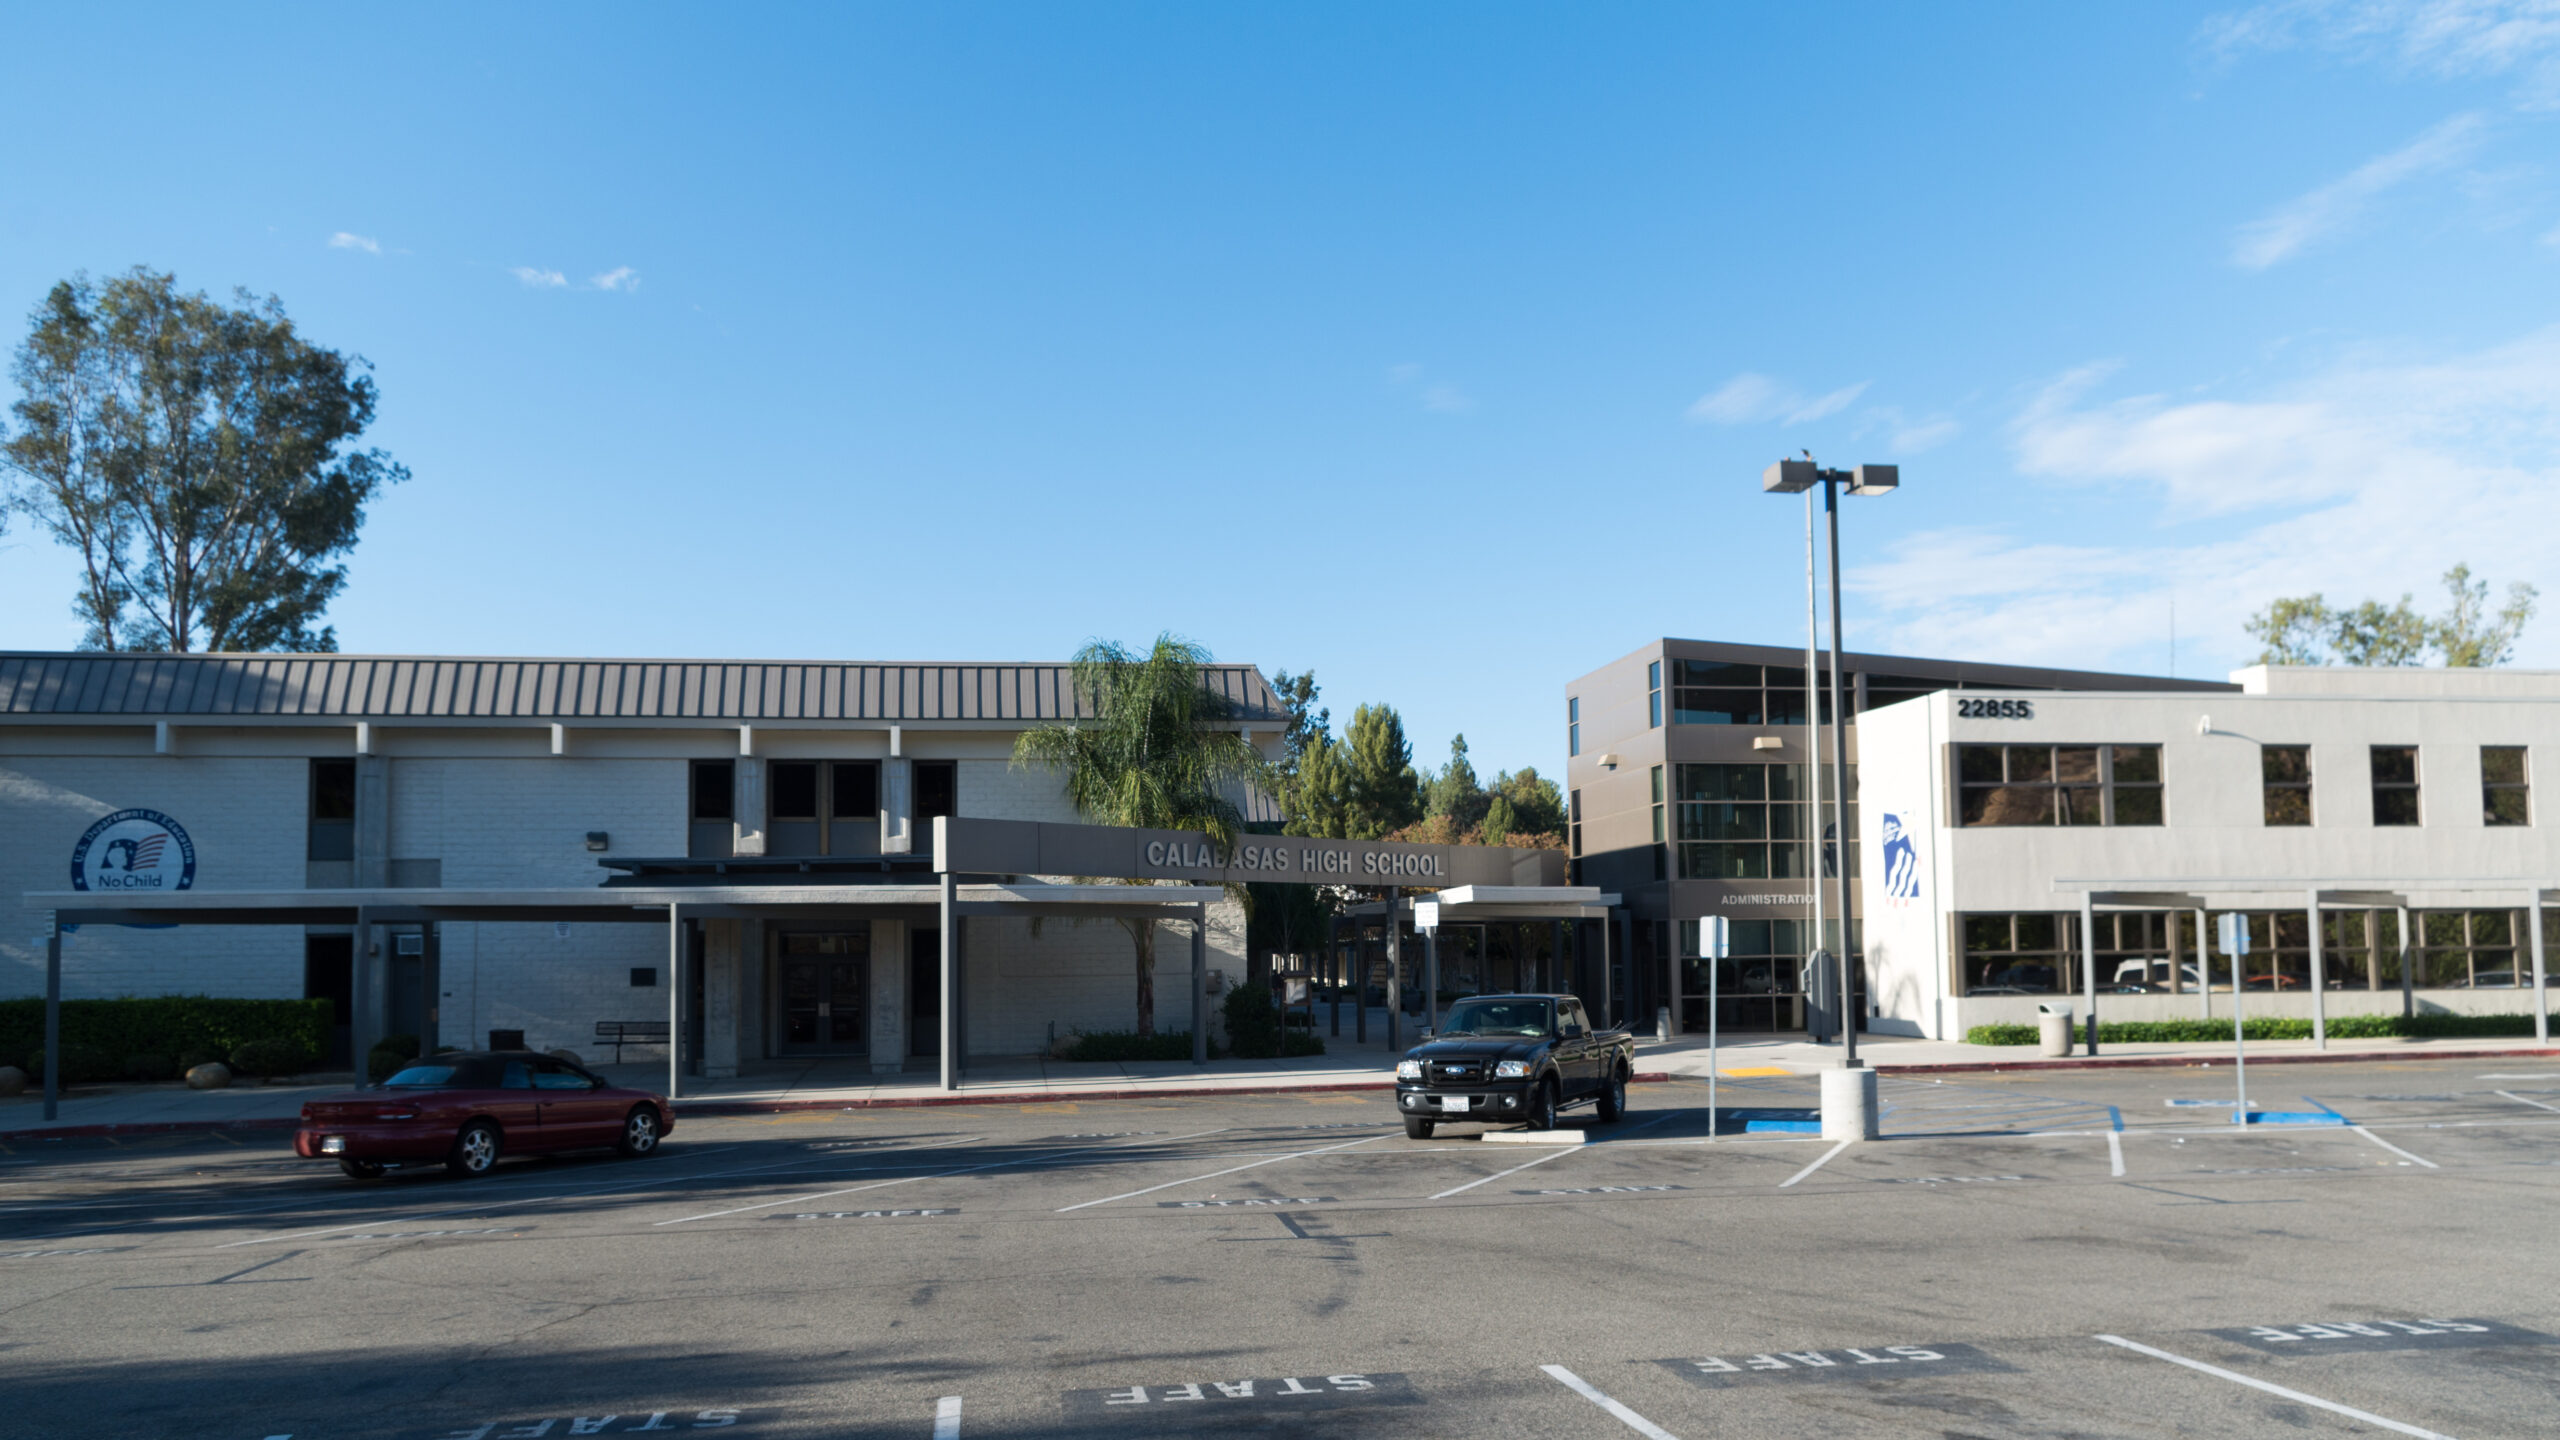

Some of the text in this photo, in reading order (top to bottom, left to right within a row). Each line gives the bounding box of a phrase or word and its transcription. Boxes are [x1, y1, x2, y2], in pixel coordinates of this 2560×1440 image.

[1957, 698, 2030, 718] 22855
[1302, 849, 1352, 874] HIGH
[1363, 852, 1446, 877] SCHOOL
[98, 874, 162, 888] No Child
[1721, 894, 1817, 905] ADMINISTRATIO
[796, 1208, 945, 1219] STAFF
[2250, 1318, 2490, 1342] STAFF
[1693, 1345, 1946, 1373] STAFF
[1104, 1373, 1376, 1405] STAFF
[438, 1408, 741, 1440] STAFF
